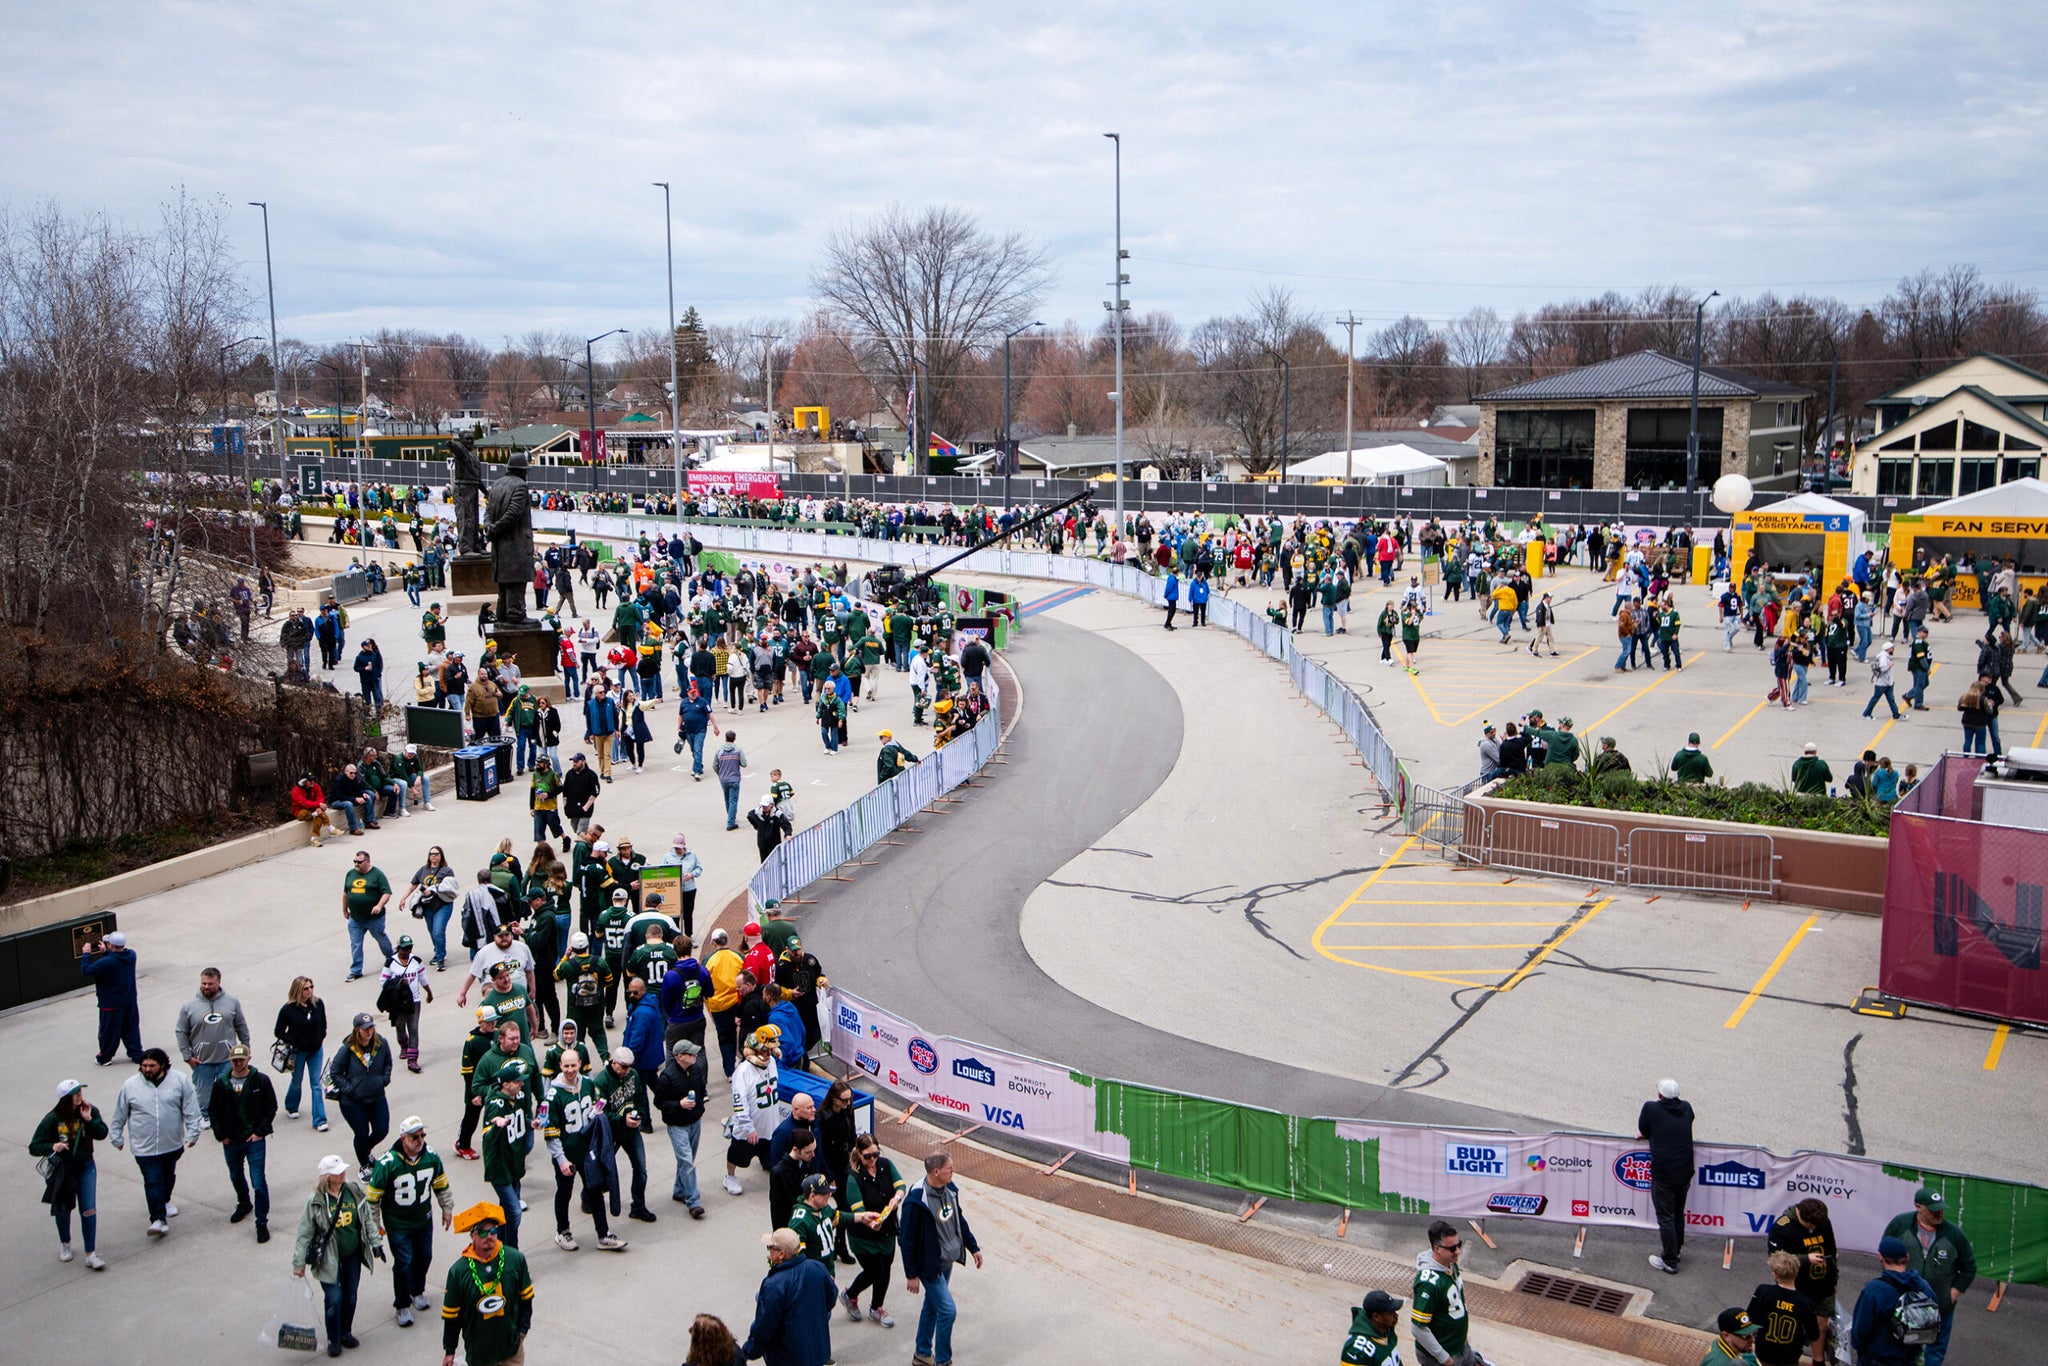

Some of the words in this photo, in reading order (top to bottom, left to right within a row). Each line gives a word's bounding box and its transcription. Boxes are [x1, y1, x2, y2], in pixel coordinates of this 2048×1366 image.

[308, 476, 316, 490] 5
[690, 473, 732, 482] EMERGENCY
[735, 473, 777, 483] EMERGENCY
[736, 483, 750, 491] EXIT
[1749, 515, 1798, 523] MOBILITY
[1756, 522, 1821, 530] ASSISTANCE
[1942, 521, 1983, 532] FAN
[824, 621, 837, 632] 87
[942, 618, 951, 630] 10
[1661, 616, 1670, 627] 10
[921, 624, 932, 635] 90
[605, 927, 625, 949] 52
[650, 951, 664, 959] LOVE
[647, 960, 668, 984] 10
[841, 1005, 858, 1022] BUD
[838, 1015, 862, 1035] LIGHT
[879, 1029, 899, 1046] Copilot
[956, 1062, 992, 1083] LOWE'S
[898, 1078, 920, 1093] TOYOTA
[1014, 1075, 1047, 1088] MARRIOTT
[1008, 1080, 1053, 1100] BONVOY
[928, 1092, 971, 1113] verizon
[564, 1095, 594, 1134] 92
[981, 1103, 1025, 1130] VISA
[505, 1108, 526, 1144] 80
[1457, 1146, 1496, 1161] BUD
[1449, 1158, 1504, 1174] LIGHT
[1549, 1155, 1592, 1168] Copilot
[1705, 1168, 1759, 1187] LOWE'S
[1795, 1173, 1845, 1186] MARRIOTT
[394, 1167, 435, 1206] 87
[1786, 1180, 1854, 1200] BONVOY
[1490, 1195, 1540, 1209] SNICKERS
[1592, 1204, 1636, 1217] TOYOTA
[1684, 1209, 1724, 1227] izon
[1742, 1211, 1776, 1233] VI
[1420, 1269, 1440, 1285] 87
[1776, 1299, 1795, 1313] LOVE
[1765, 1311, 1797, 1344] 10
[1353, 1335, 1377, 1358] 29
